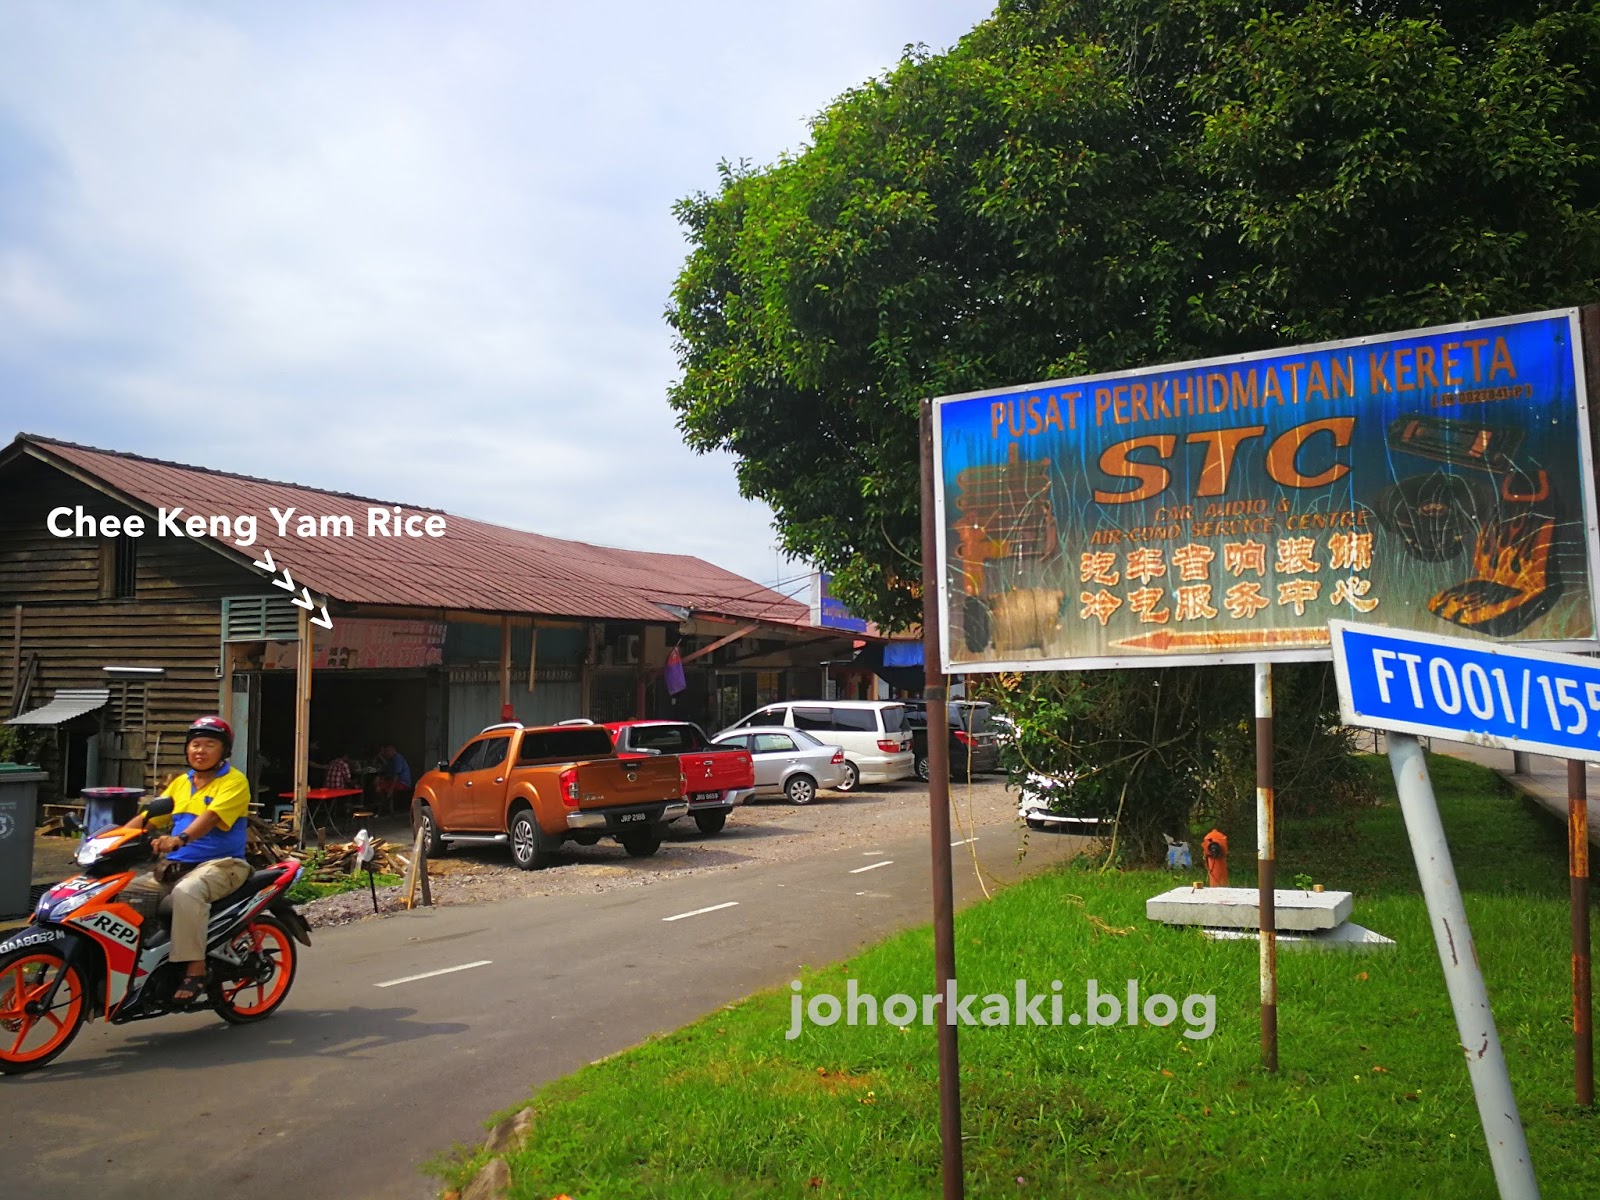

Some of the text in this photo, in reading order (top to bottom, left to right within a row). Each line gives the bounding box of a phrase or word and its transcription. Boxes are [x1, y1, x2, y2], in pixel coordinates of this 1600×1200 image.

[991, 337, 1517, 438] PUSAT PERKHIDMATAN KERETA
[1094, 417, 1356, 503] STC
[1090, 509, 1370, 546] AIR-COND SERVICE CENTRE
[1155, 497, 1290, 523] CAR AUDIO &
[1080, 576, 1379, 625] 冷气服务中心
